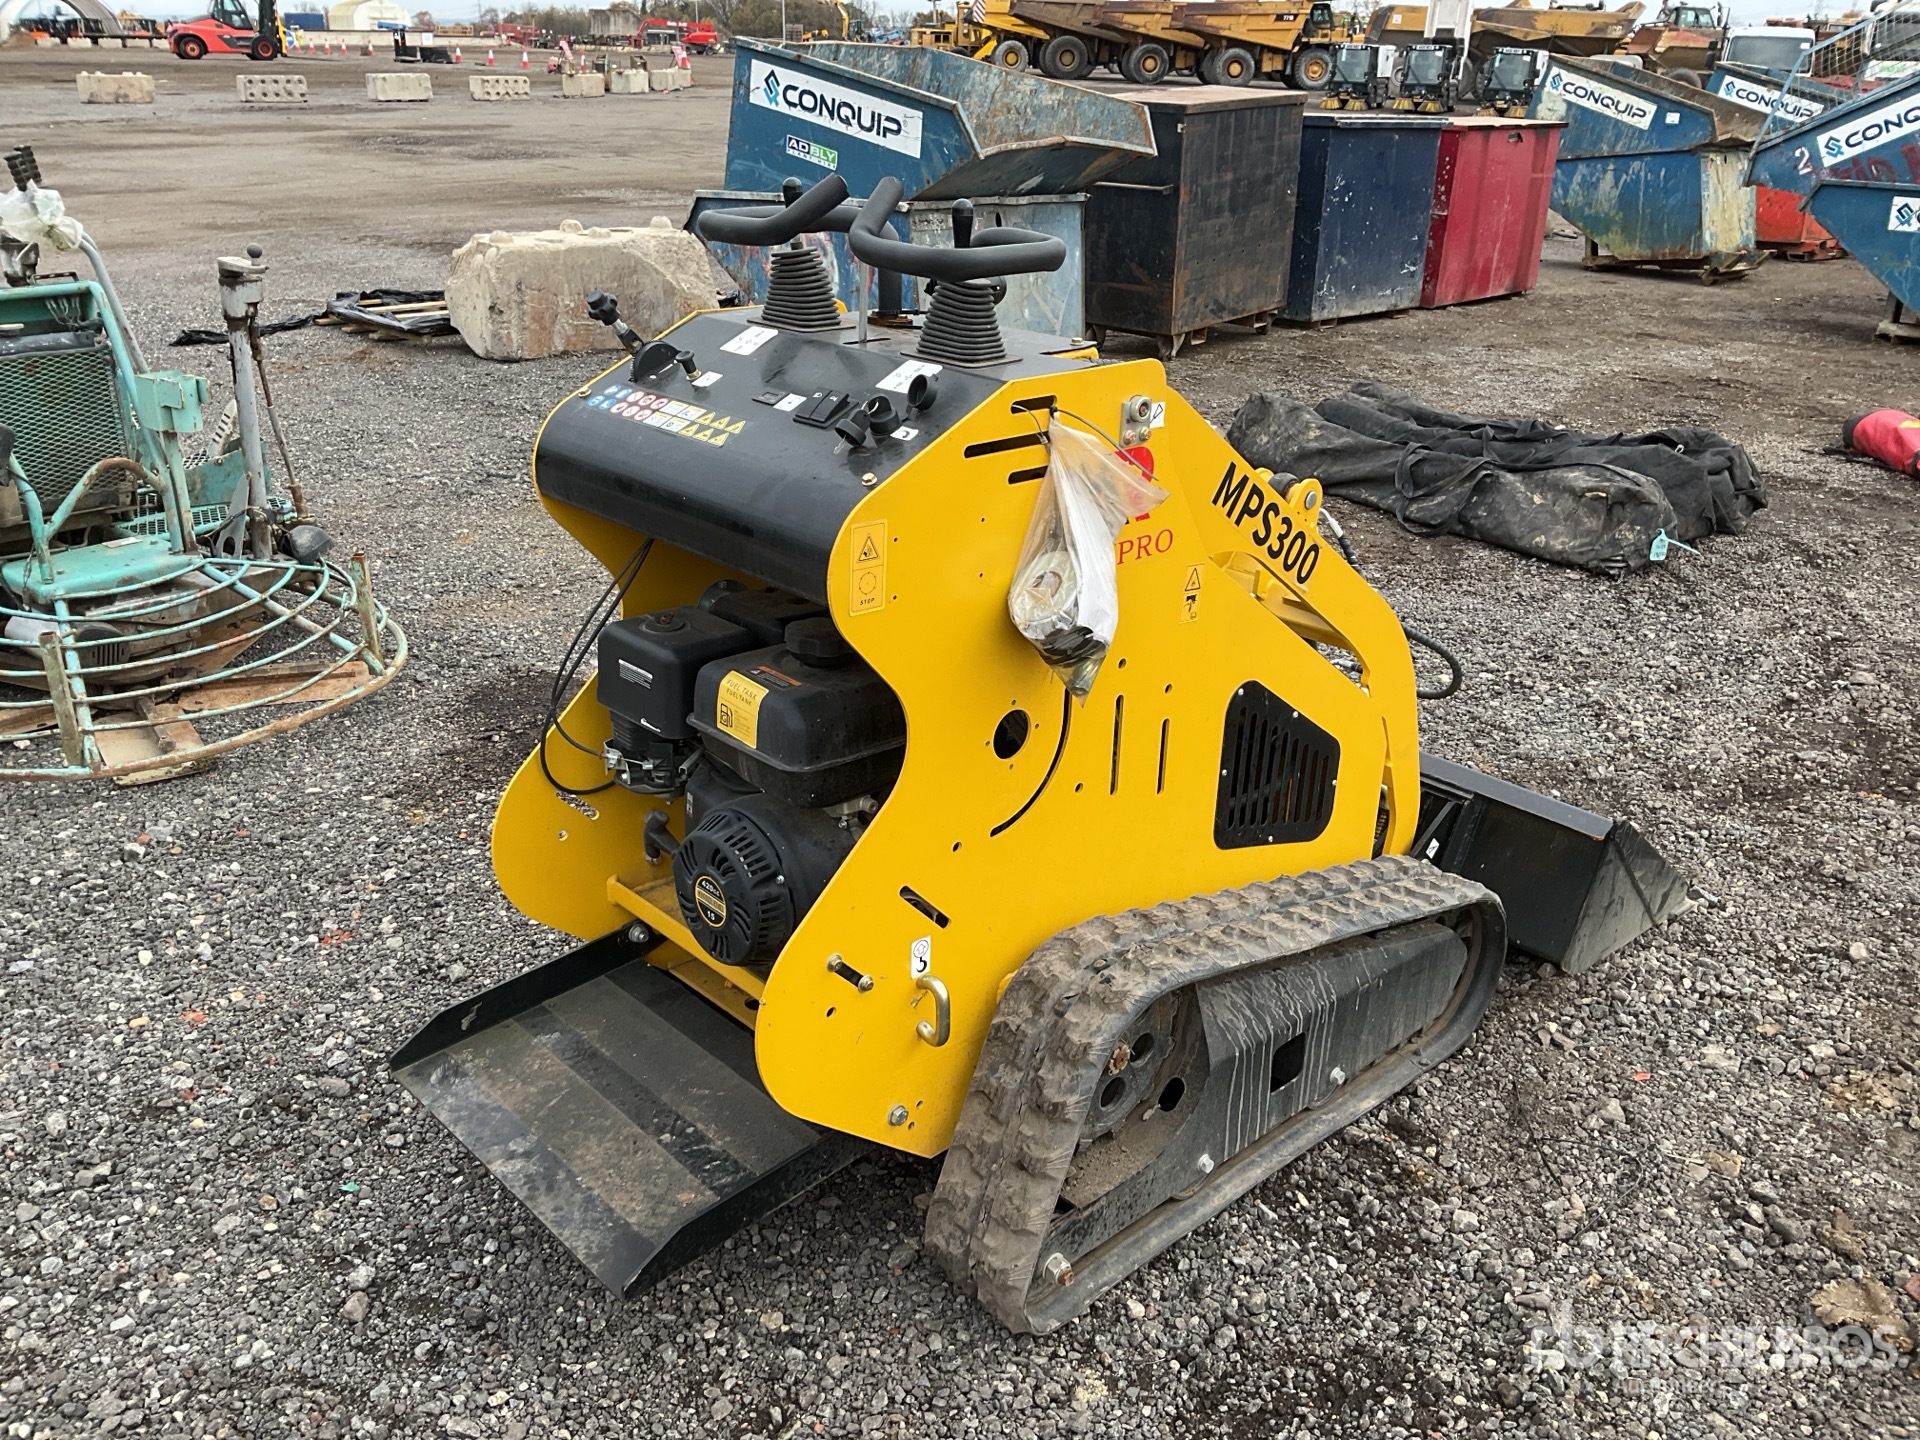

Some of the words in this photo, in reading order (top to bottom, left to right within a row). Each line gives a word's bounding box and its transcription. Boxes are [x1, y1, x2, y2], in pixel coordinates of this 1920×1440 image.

[782, 84, 902, 138] CONQUIP
[1563, 81, 1647, 119] CONQUIP
[1845, 106, 1920, 148] CONQ
[1794, 146, 1813, 176] 2
[1211, 461, 1320, 584] MPS300
[1117, 528, 1174, 566] PRO
[860, 597, 875, 606] STOP
[726, 679, 741, 692] FUEL
[741, 687, 758, 700] TANK
